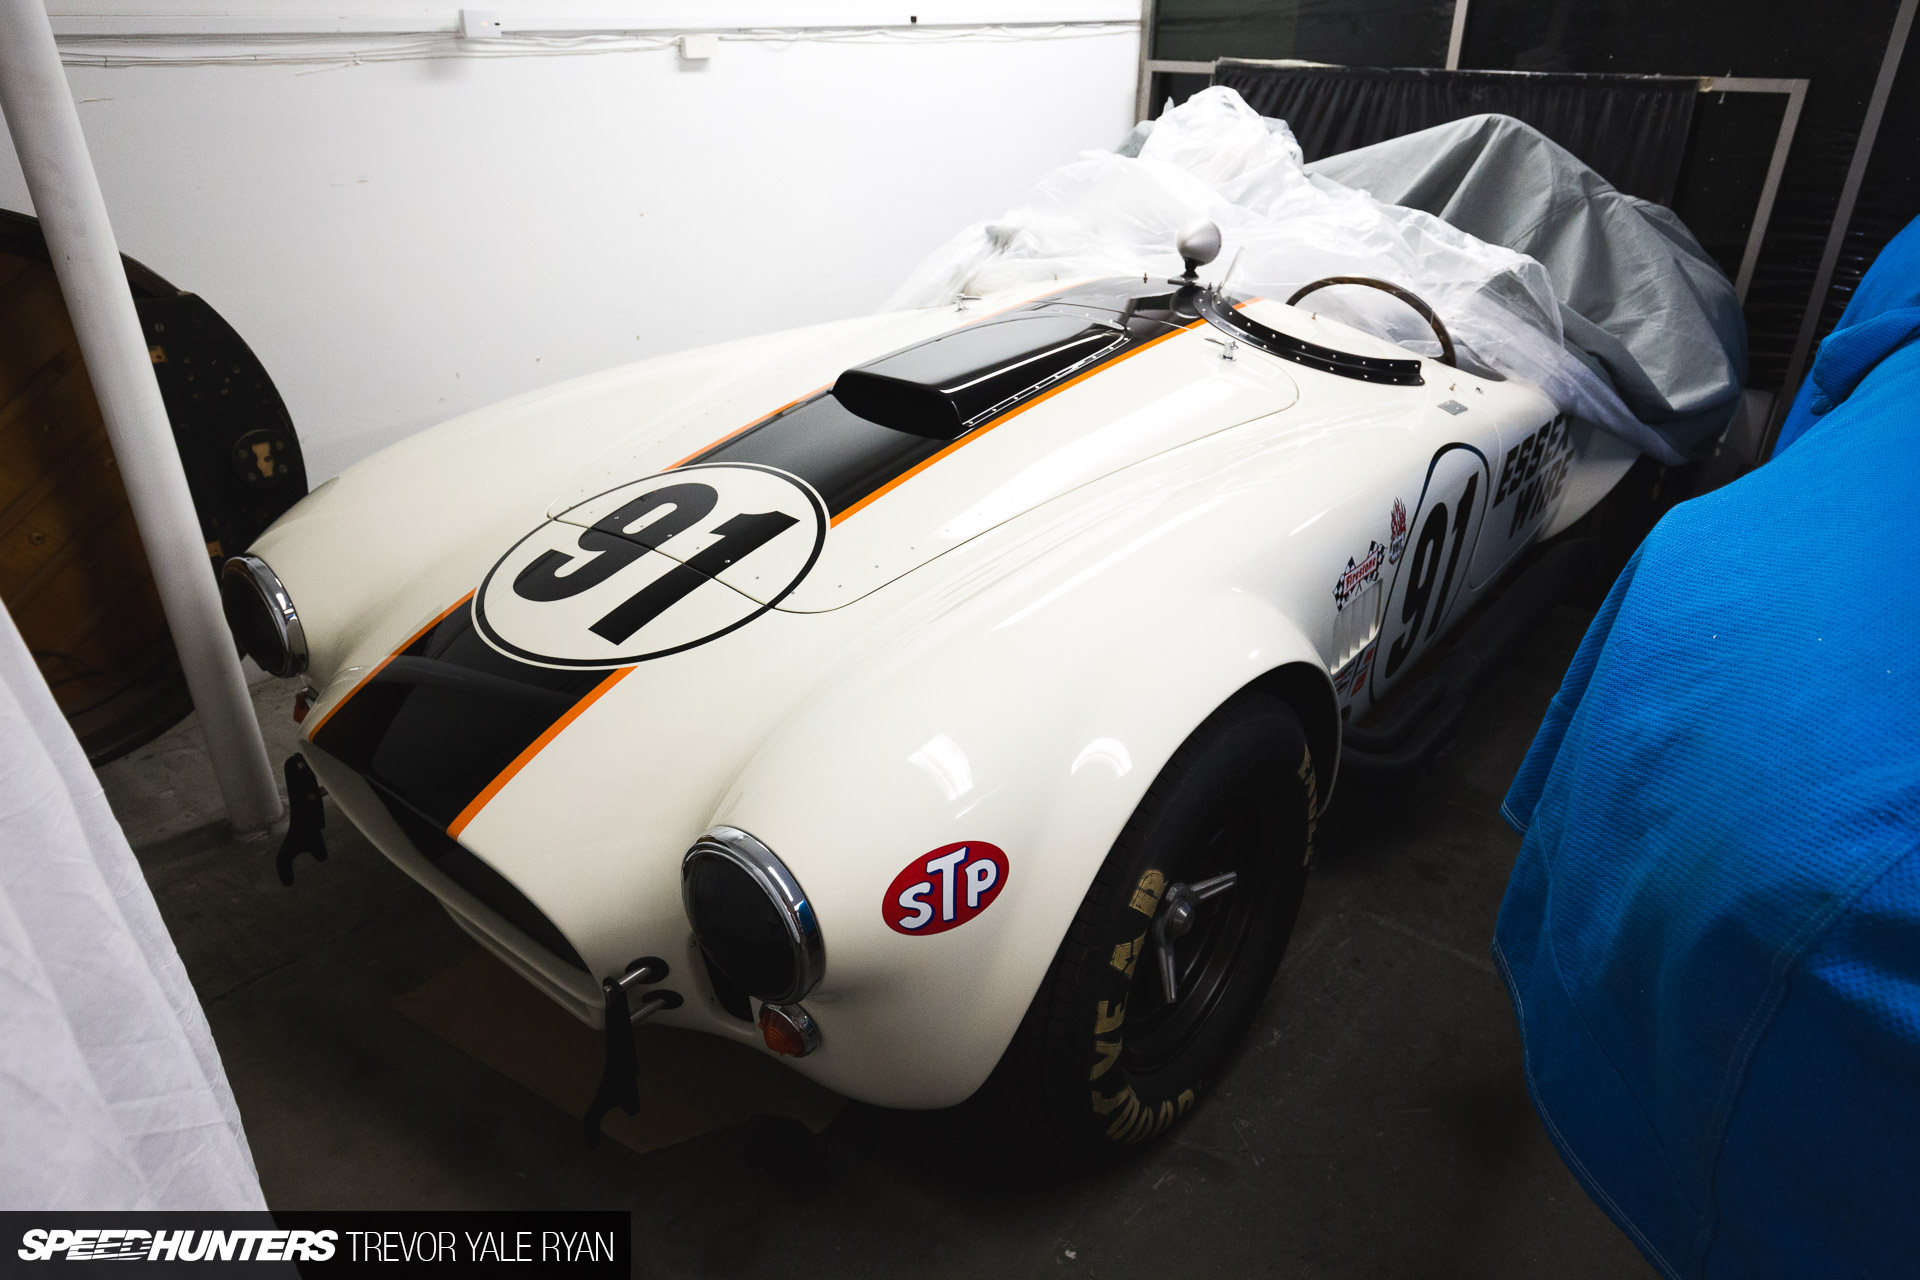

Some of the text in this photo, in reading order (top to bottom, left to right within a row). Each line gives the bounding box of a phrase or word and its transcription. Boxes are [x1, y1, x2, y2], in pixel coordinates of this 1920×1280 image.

[1492, 411, 1574, 510] ESSEX
[1508, 447, 1575, 541] WIRE
[512, 482, 801, 647] 91
[1345, 556, 1377, 590] Firestone
[1384, 470, 1480, 680] 91
[897, 845, 1001, 931] STP
